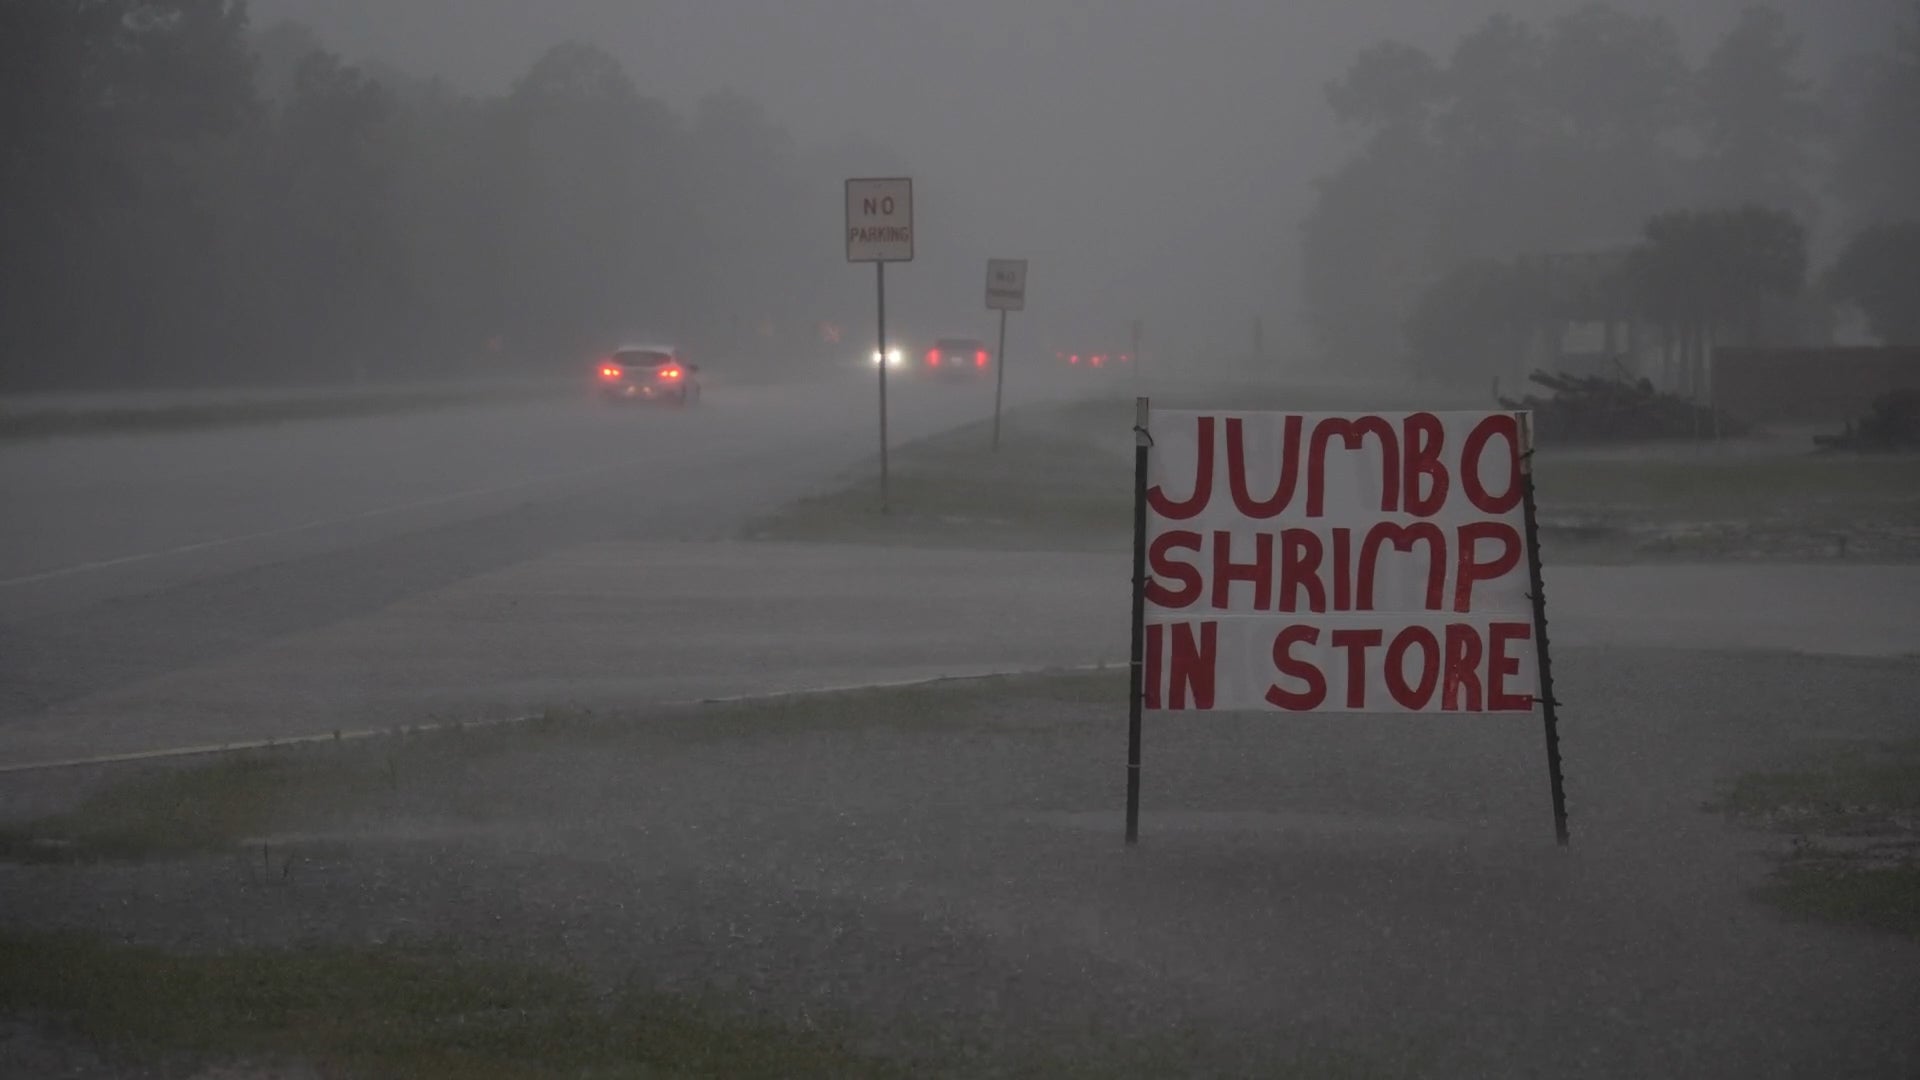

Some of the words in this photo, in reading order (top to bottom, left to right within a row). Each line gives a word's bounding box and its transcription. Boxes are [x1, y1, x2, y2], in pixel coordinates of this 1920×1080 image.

[849, 226, 909, 243] PARKING
[863, 196, 894, 215] NO
[1147, 412, 1523, 520] JUMBO
[1144, 521, 1522, 613] SHRIMP
[1145, 621, 1217, 710] IN
[1265, 622, 1533, 711] STORE
